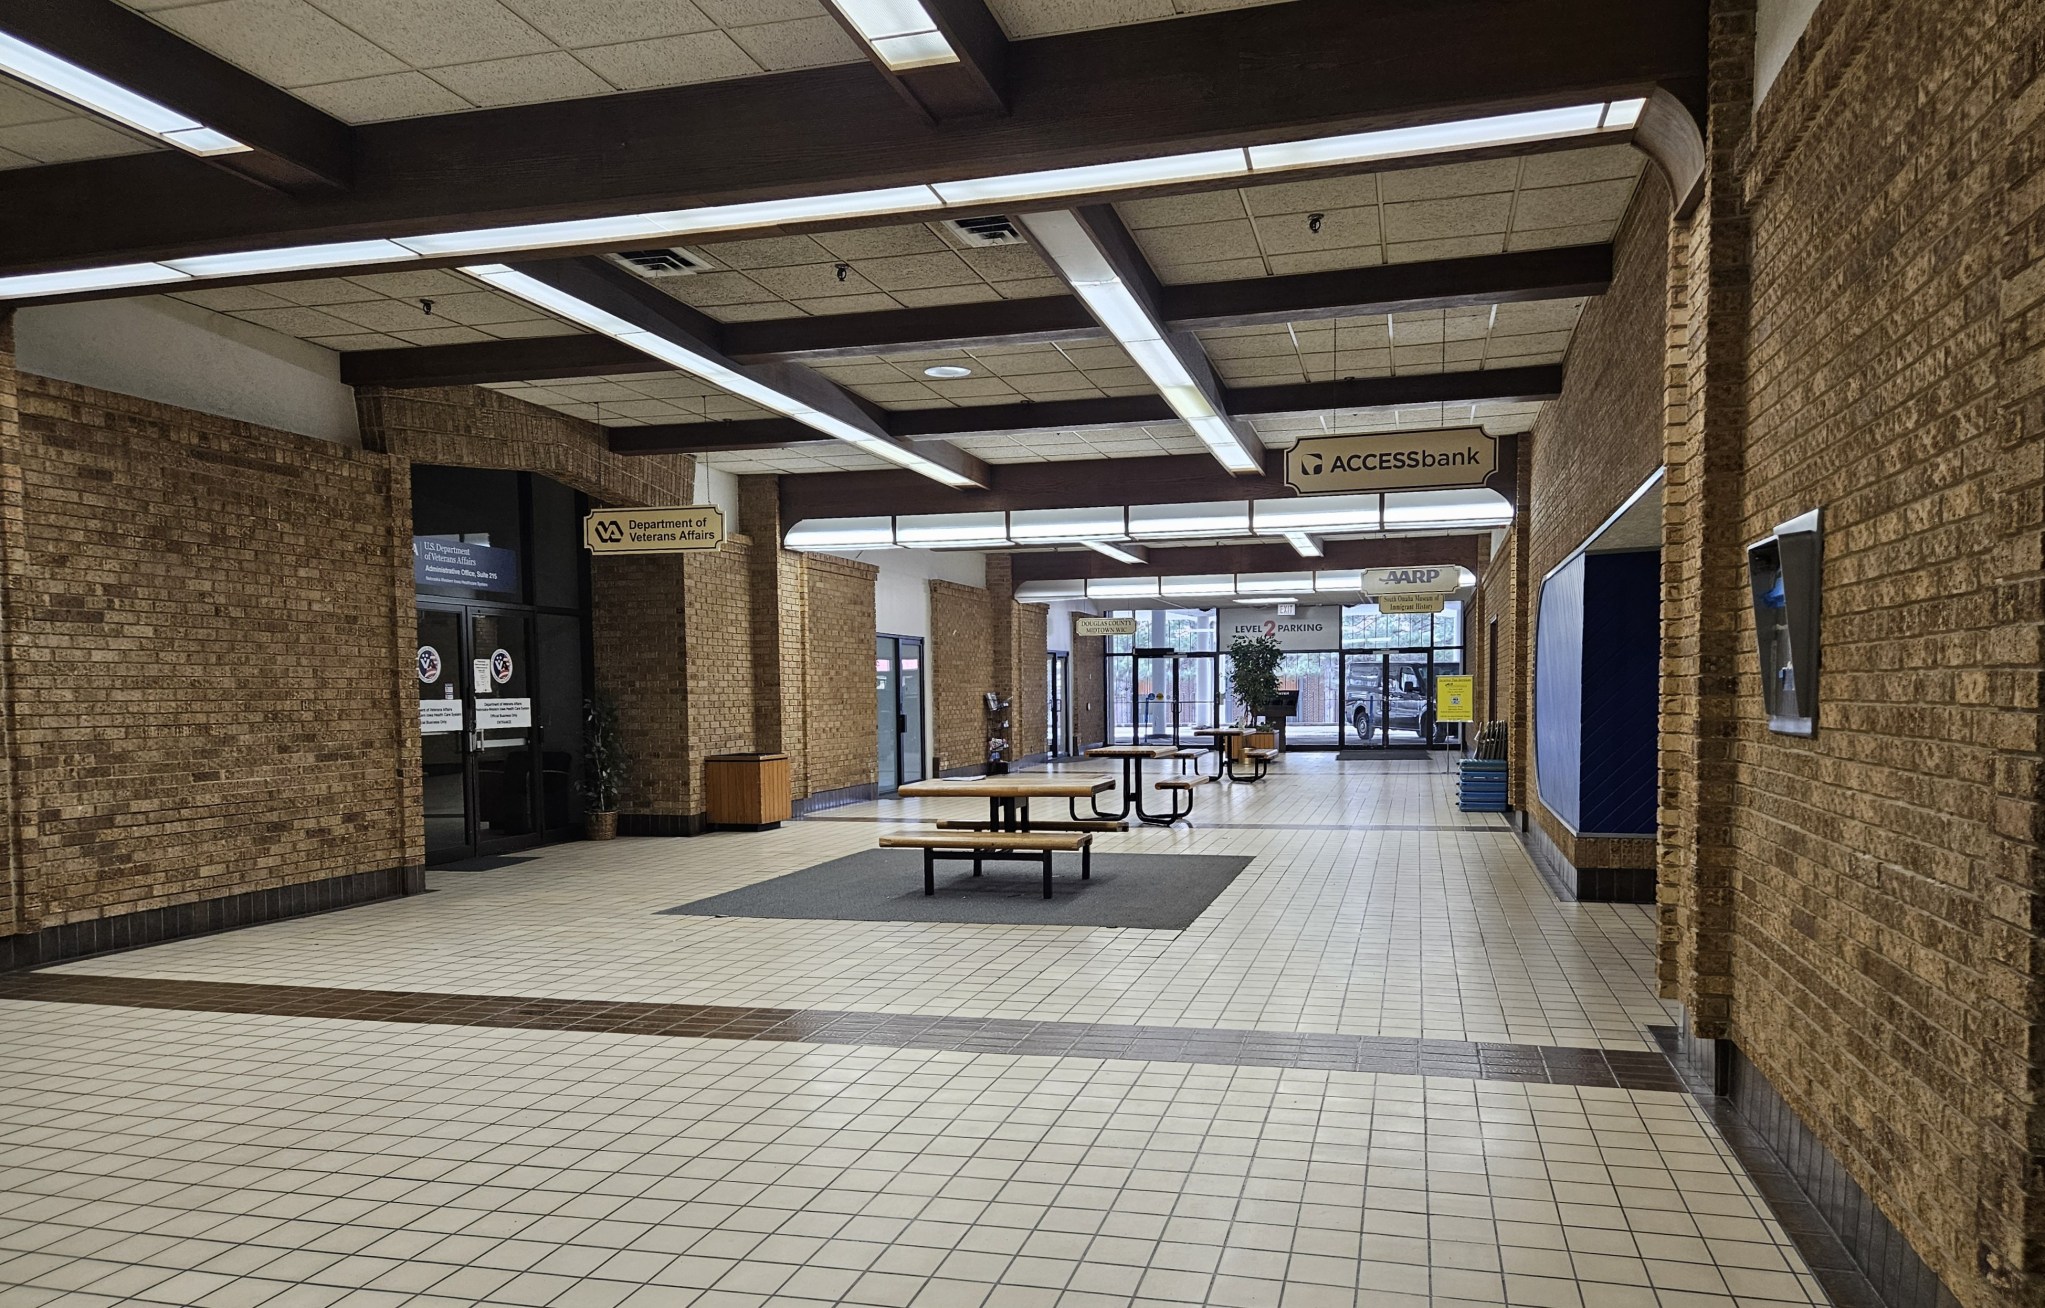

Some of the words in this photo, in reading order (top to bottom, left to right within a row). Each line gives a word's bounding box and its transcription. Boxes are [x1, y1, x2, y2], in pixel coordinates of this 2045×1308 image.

[1330, 447, 1480, 473] ACCESSbank
[629, 519, 692, 532] Department
[696, 517, 708, 528] of
[630, 532, 676, 542] Veterans
[679, 530, 714, 540] Affairs
[424, 542, 435, 550] U.S.
[436, 543, 470, 556] Department
[430, 553, 456, 564] Veterans
[456, 556, 476, 566] Affairs
[425, 564, 460, 575] Administrative
[461, 569, 476, 578] Office,
[1379, 569, 1440, 584] AARP
[1280, 605, 1293, 614] EXIT
[1264, 620, 1276, 636] 2
[1278, 624, 1323, 632] PARKING
